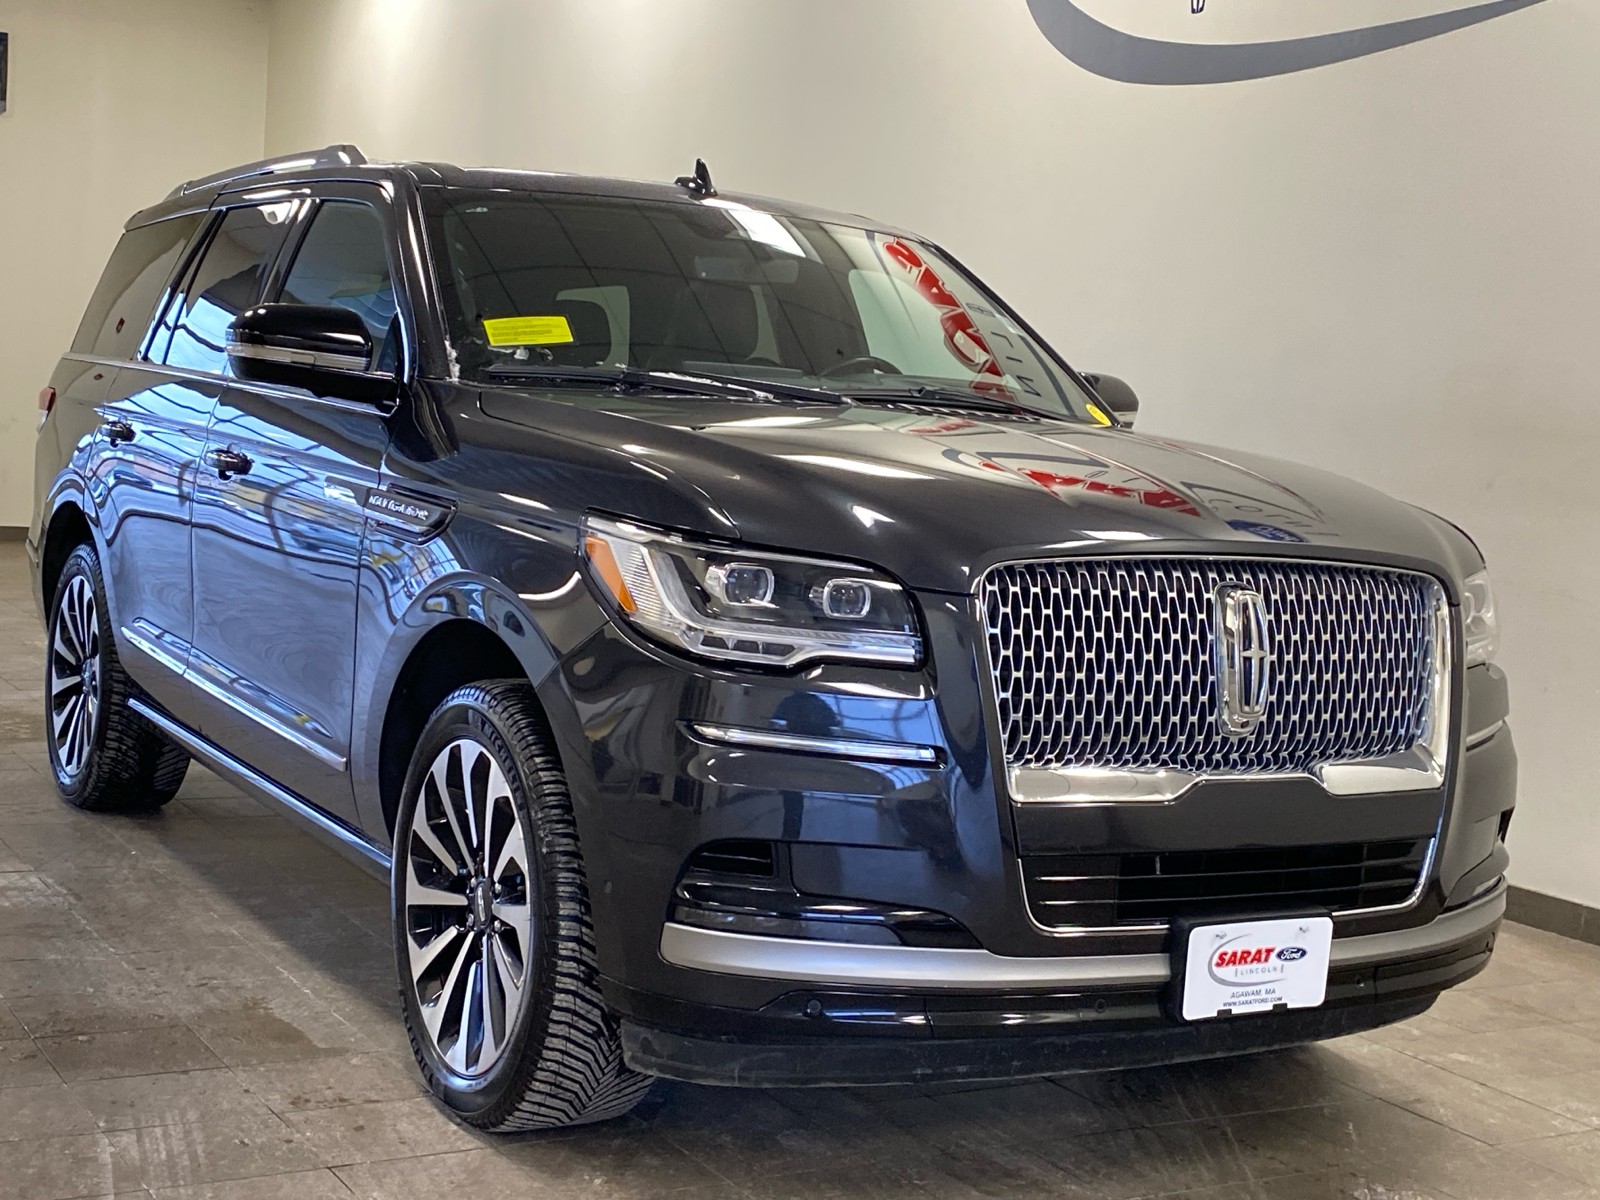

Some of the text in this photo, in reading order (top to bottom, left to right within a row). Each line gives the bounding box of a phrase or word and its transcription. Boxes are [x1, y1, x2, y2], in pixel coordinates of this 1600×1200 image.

[368, 495, 429, 520] NAVIGATOR
[1214, 947, 1304, 968] SARAT Ford
[1240, 967, 1278, 976] LINCOLN
[1230, 989, 1263, 999] AGAWAM,
